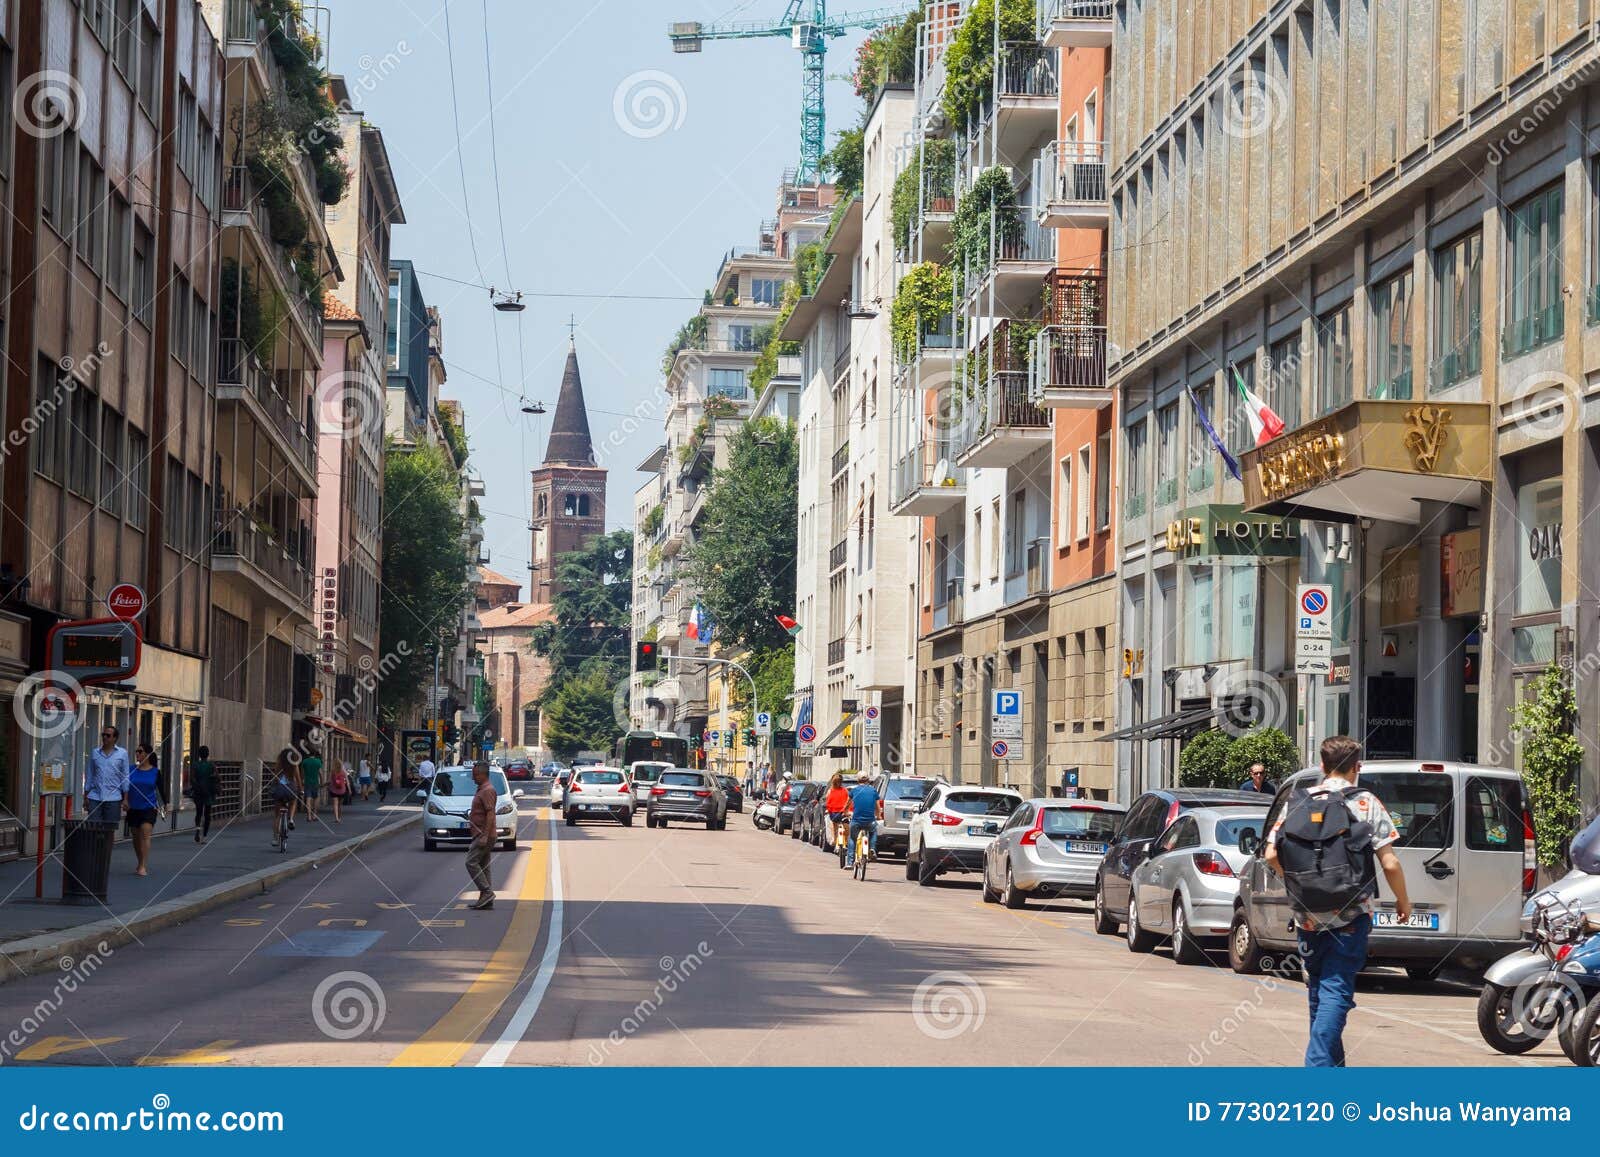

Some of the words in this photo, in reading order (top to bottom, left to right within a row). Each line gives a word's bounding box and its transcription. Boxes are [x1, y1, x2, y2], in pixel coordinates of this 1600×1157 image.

[1214, 521, 1297, 539] HOTEL
[1530, 523, 1563, 561] OAK
[111, 593, 140, 608] Leica
[322, 567, 336, 673] RISTORANTE
[1302, 618, 1310, 628] P
[1001, 695, 1015, 713] P
[1367, 718, 1414, 727] visionnaire
[1378, 913, 1392, 925] CX
